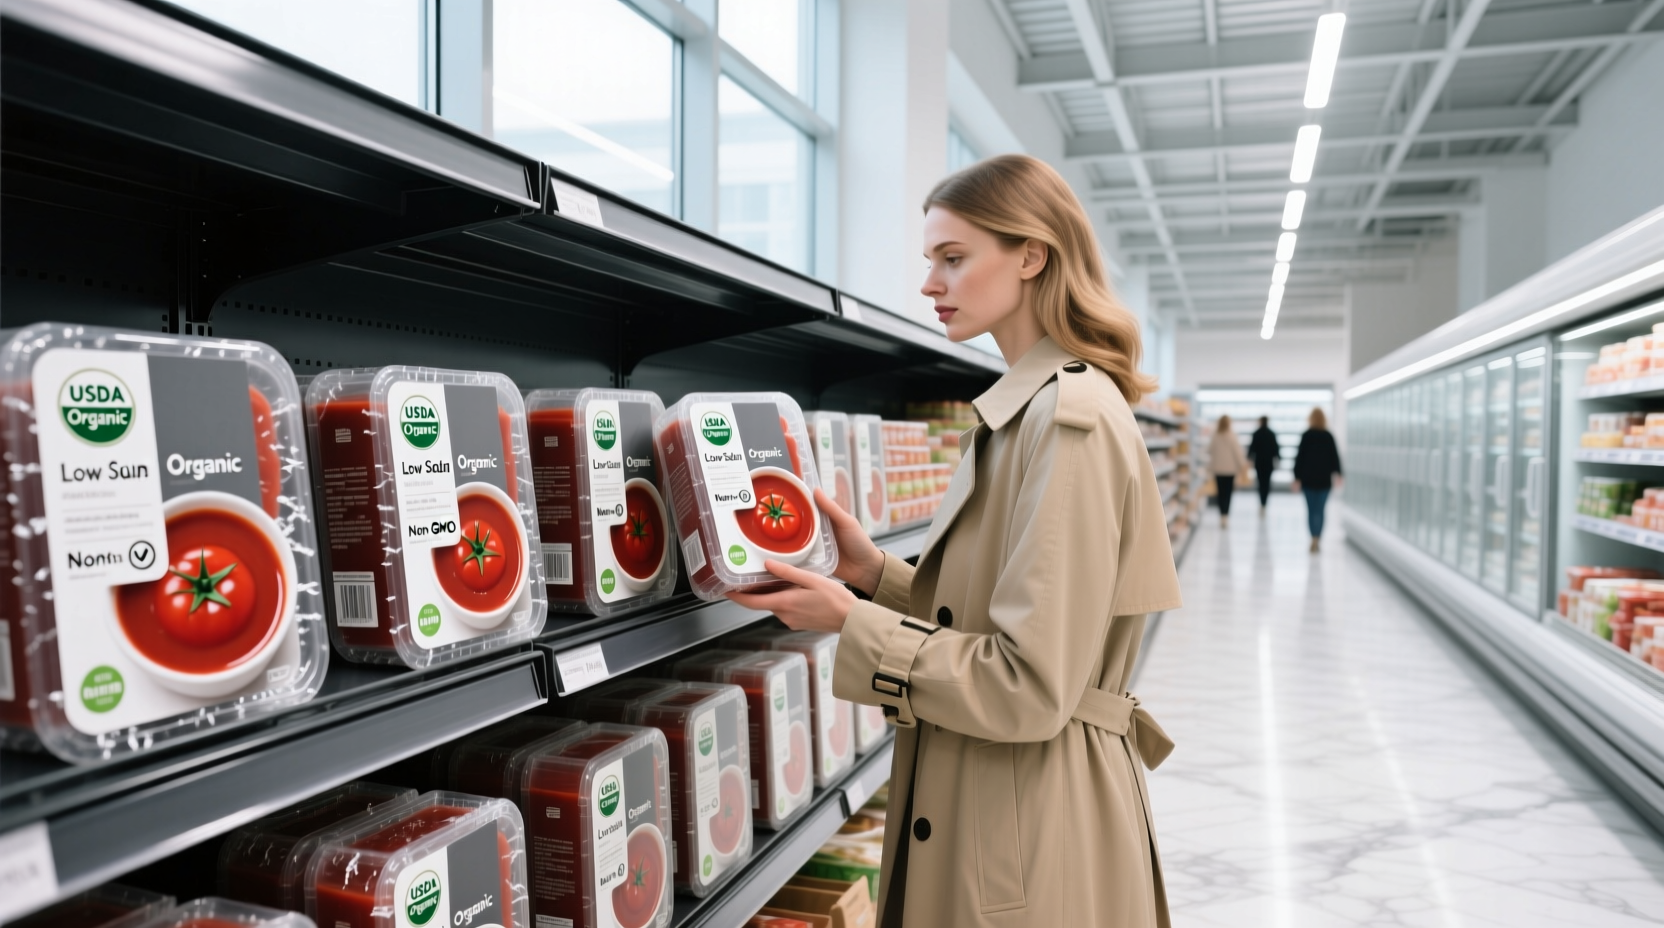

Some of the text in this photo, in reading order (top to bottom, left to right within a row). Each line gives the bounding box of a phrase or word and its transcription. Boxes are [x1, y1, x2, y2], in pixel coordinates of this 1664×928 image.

[70, 384, 126, 403] USDA
[67, 409, 128, 430] Organic
[405, 405, 436, 419] USDA
[61, 462, 102, 483] Low
[167, 452, 243, 481] Organic
[402, 461, 423, 475] Low
[408, 524, 429, 537] Non
